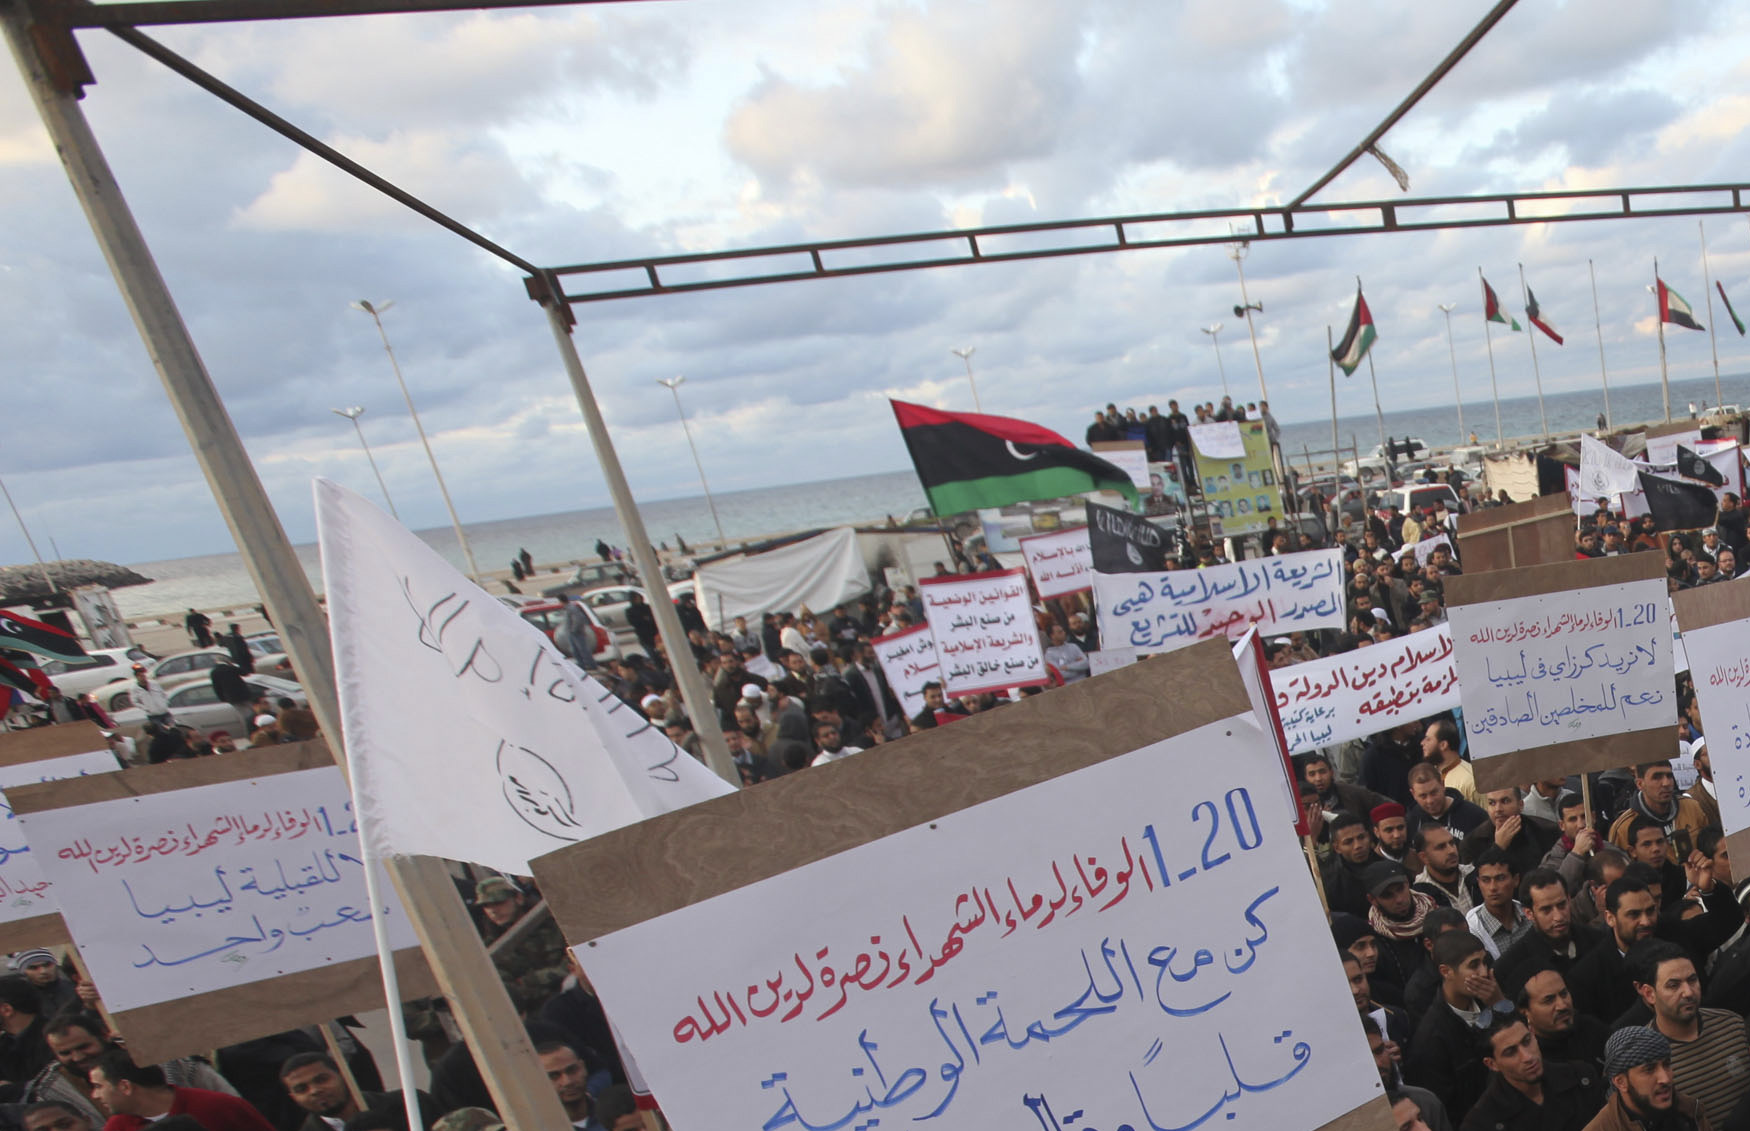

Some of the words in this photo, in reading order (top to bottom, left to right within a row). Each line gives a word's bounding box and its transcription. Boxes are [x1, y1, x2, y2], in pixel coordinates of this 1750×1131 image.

[1274, 558, 1341, 589] الشريعة
[1004, 613, 1015, 625] من
[1281, 593, 1342, 619] المصدر
[950, 615, 977, 632] البشر
[980, 614, 1000, 630] صنع
[1471, 627, 1494, 643] الله
[948, 664, 974, 680] البشر
[977, 661, 1000, 676] خالق
[1005, 660, 1024, 674] صنع
[1028, 658, 1038, 669] من
[1487, 650, 1527, 688] ليبيا
[1550, 643, 1605, 681] كرزاي
[1600, 651, 1638, 674] نريد
[1352, 664, 1387, 690] دين
[1472, 691, 1538, 734] الصادقين
[1621, 690, 1663, 719] نعم
[1065, 836, 1154, 918] الوفاء
[123, 866, 232, 923] ليبيا
[133, 915, 284, 968] واحد
[887, 886, 1000, 988] الشهداء
[1224, 886, 1279, 974] كن
[1147, 943, 1232, 1018] مع
[673, 990, 746, 1044] الله
